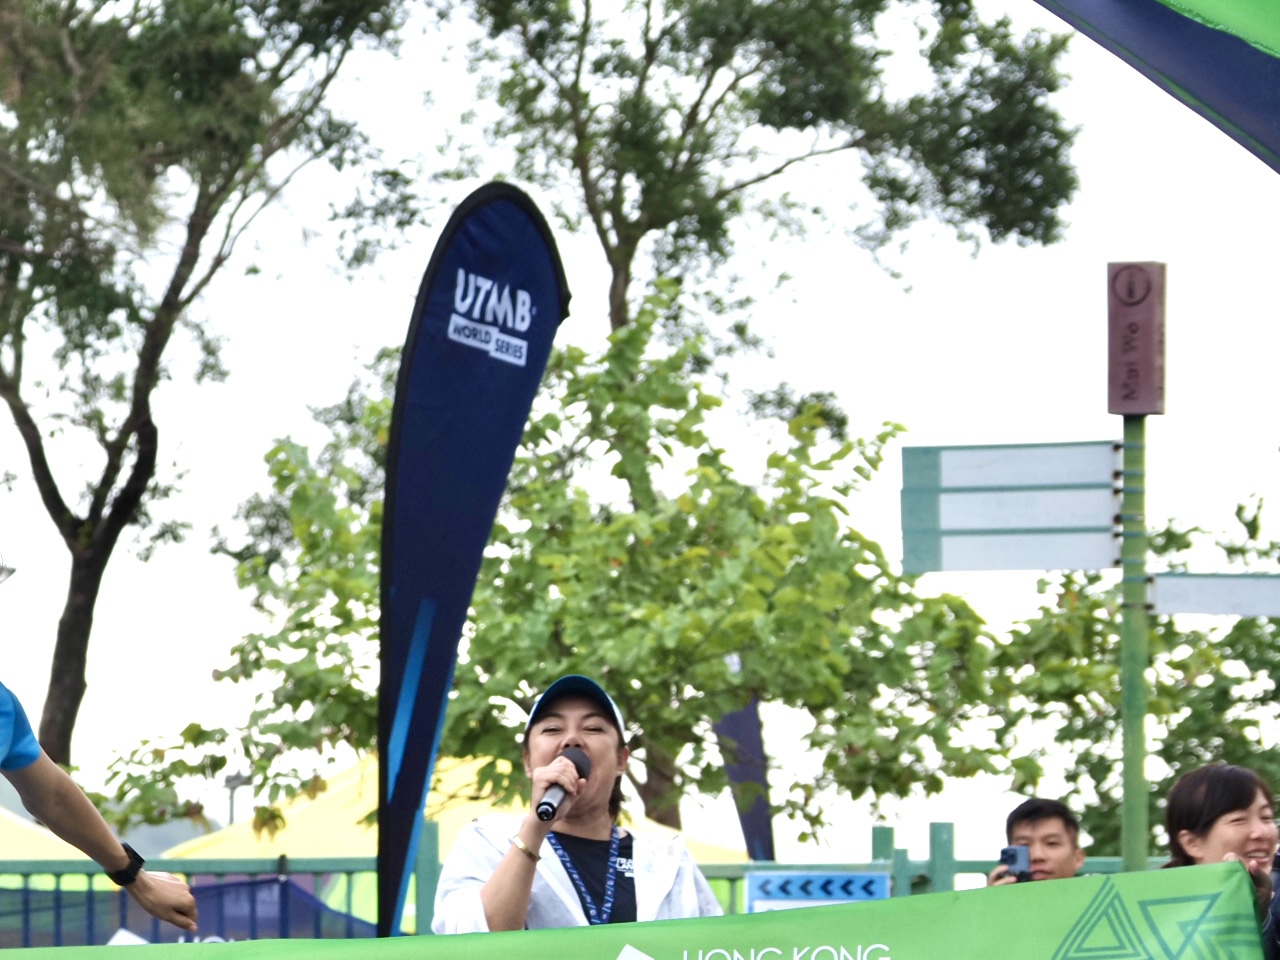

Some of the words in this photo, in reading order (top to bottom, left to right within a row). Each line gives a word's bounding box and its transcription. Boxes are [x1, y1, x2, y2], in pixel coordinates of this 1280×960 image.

[455, 267, 532, 333] UTMB
[452, 324, 493, 345] WORLD
[495, 338, 524, 360] SERIES
